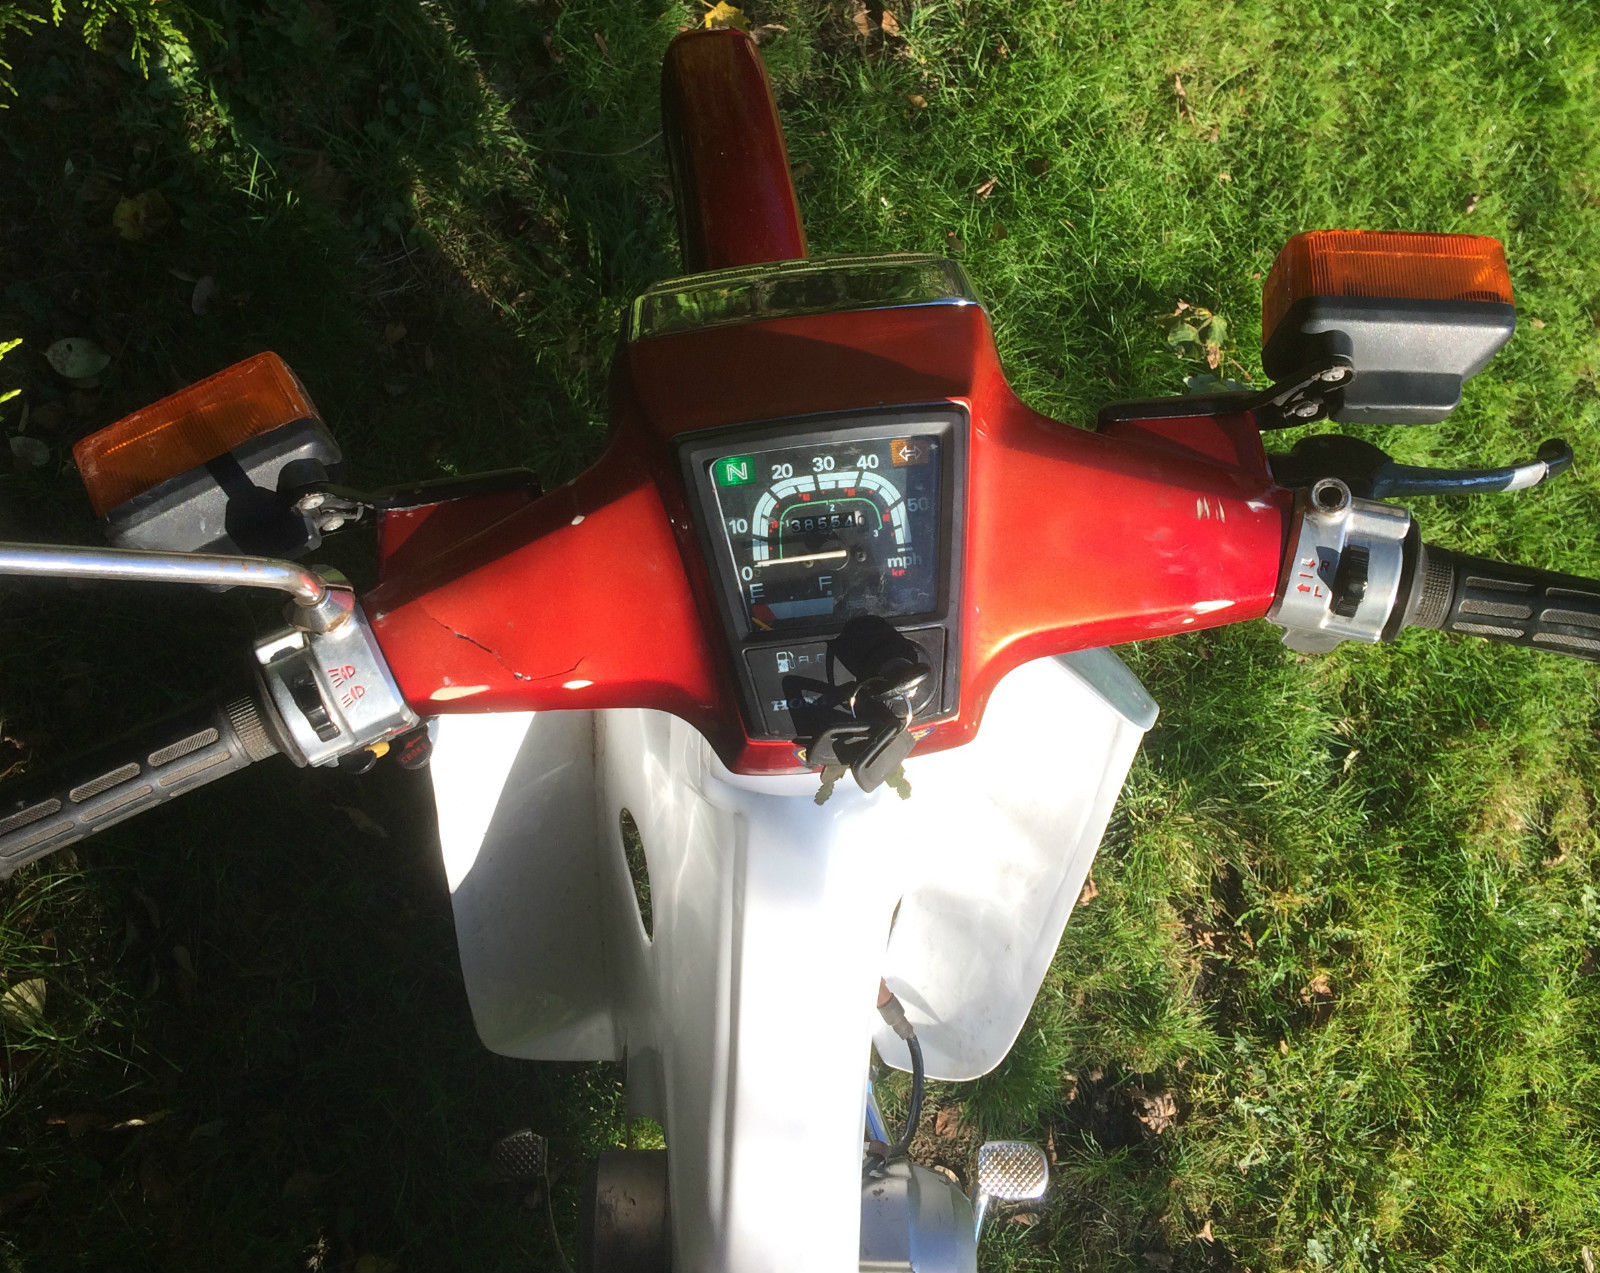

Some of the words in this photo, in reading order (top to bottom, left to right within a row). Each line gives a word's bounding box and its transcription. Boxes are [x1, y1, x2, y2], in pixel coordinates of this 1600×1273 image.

[812, 456, 835, 472] 30
[856, 454, 879, 470] 40
[726, 461, 748, 481] N
[771, 463, 793, 480] 20
[830, 504, 836, 512] 2
[907, 497, 930, 512] 50
[729, 519, 748, 535] 10
[873, 529, 879, 538] 3
[887, 552, 922, 569] mph
[1320, 559, 1330, 571] R
[741, 566, 754, 582] 0
[750, 582, 765, 600] E
[818, 575, 833, 592] F
[1314, 585, 1323, 598] L
